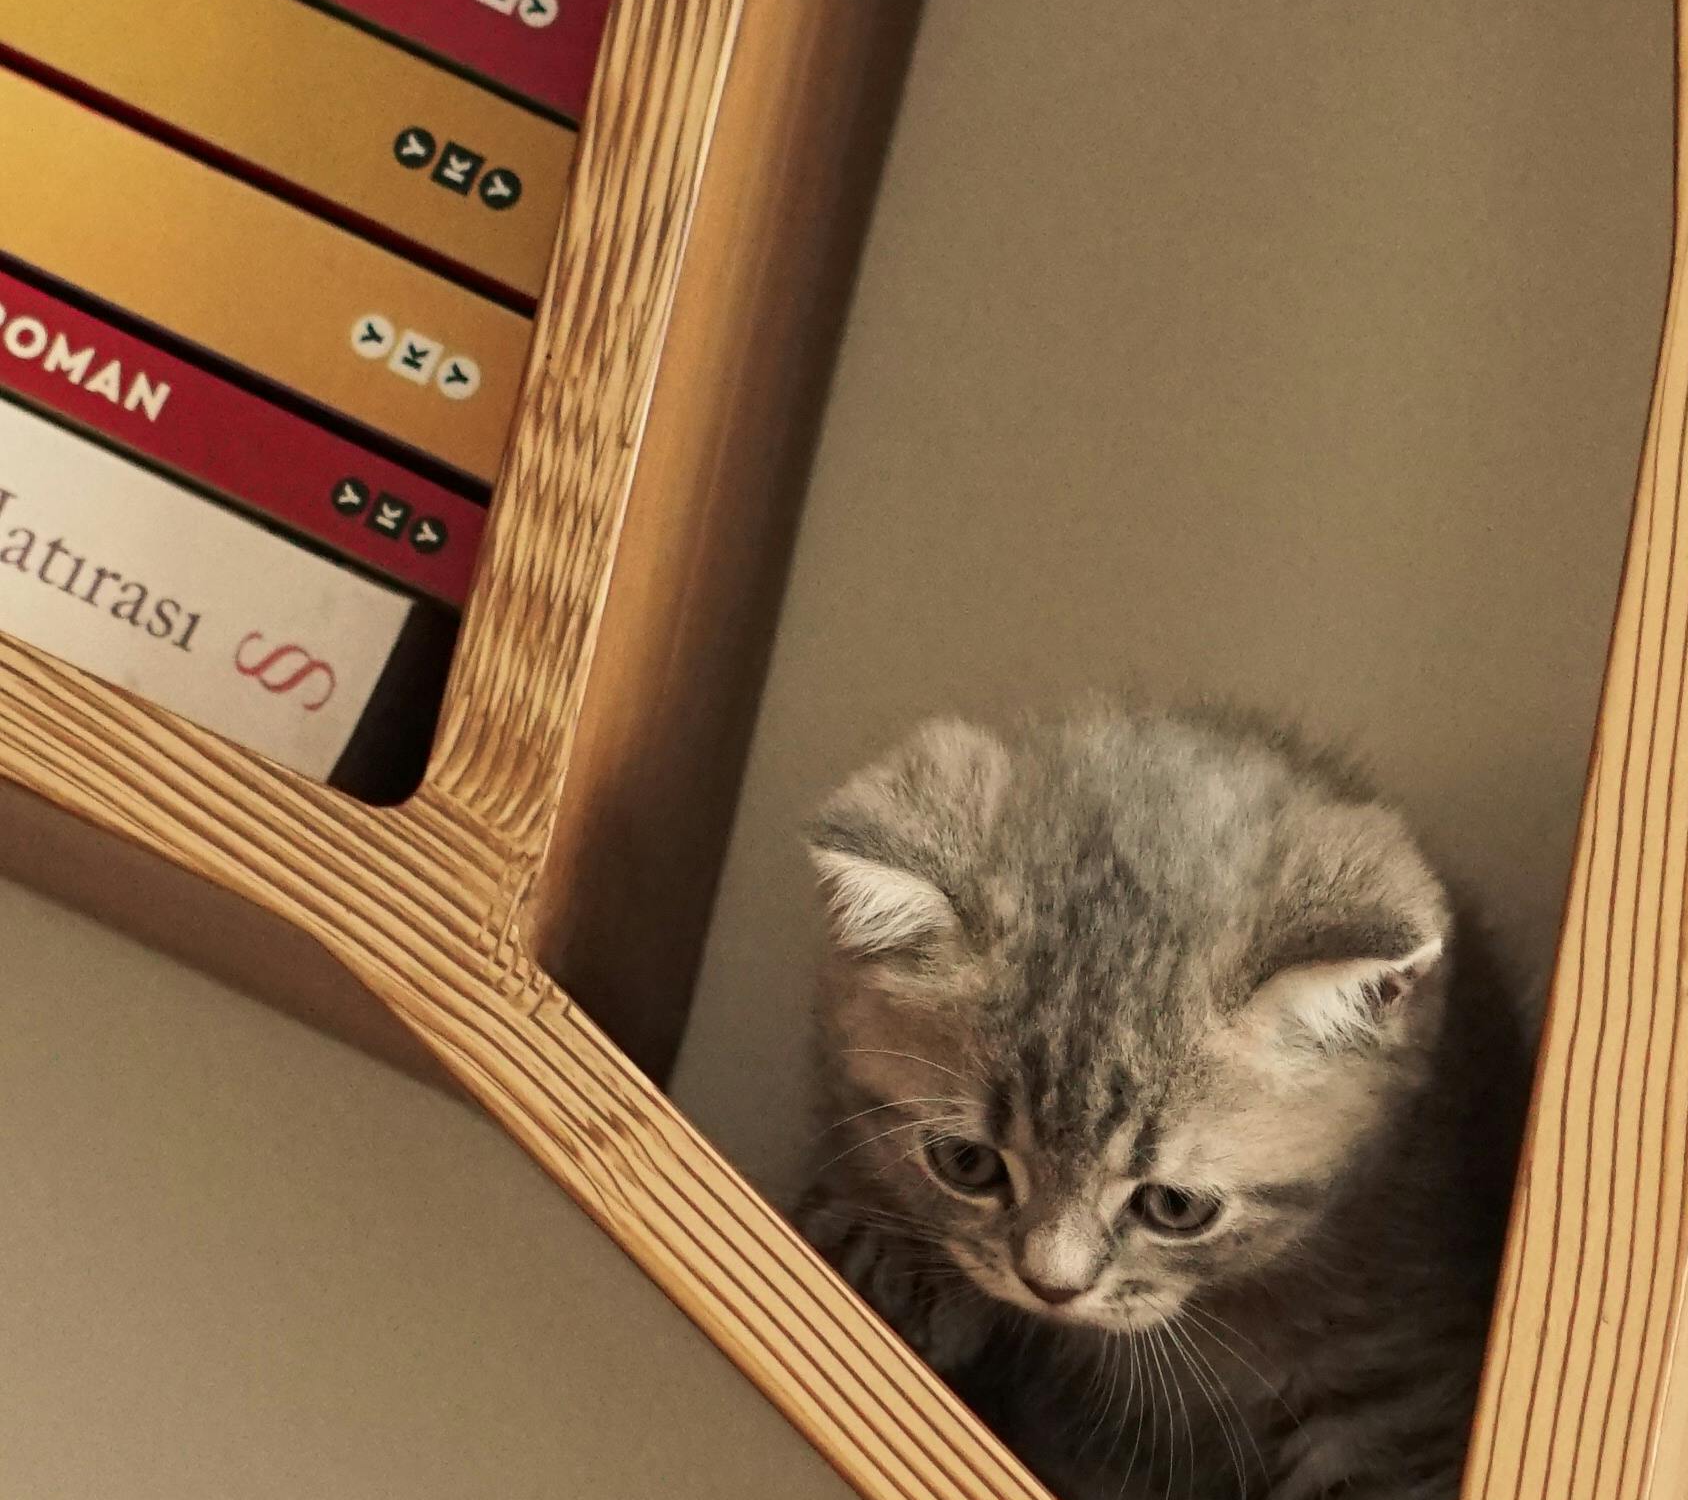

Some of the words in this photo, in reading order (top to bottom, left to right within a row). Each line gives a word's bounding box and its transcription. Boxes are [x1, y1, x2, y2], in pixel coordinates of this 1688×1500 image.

[393, 126, 523, 211] YKY
[0, 306, 172, 422] OMAN
[350, 314, 482, 400] YKY
[330, 476, 449, 556] YKY
